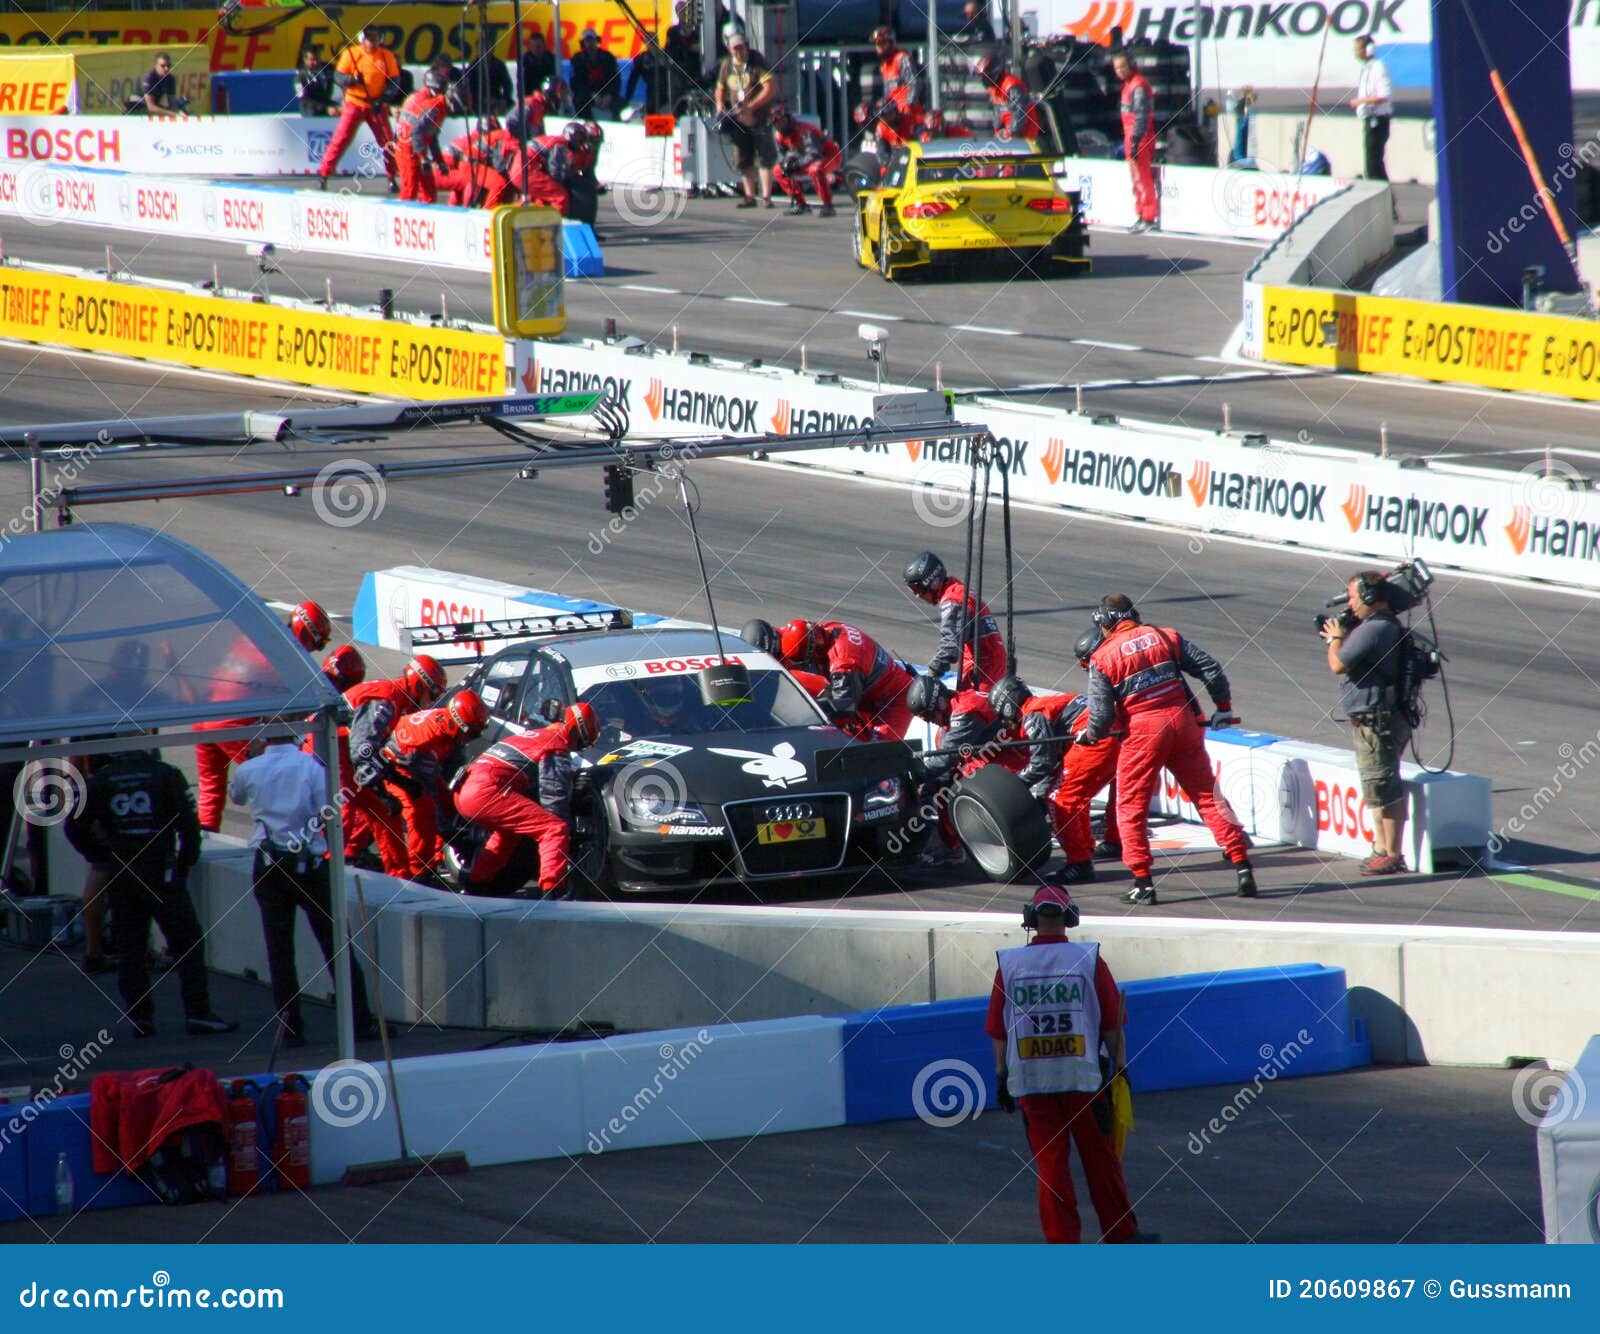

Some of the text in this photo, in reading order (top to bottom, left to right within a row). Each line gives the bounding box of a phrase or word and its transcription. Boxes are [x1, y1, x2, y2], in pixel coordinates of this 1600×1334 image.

[6, 128, 121, 163] BOSCH
[175, 144, 224, 156] SACHS
[55, 179, 97, 212] BOSCH
[136, 188, 179, 221] BOSCH
[223, 198, 265, 231] BOSCH
[306, 207, 349, 241] BOSCH
[393, 216, 436, 251] BOSCH
[502, 404, 536, 415] BRUNO
[644, 655, 746, 676] BOSCH
[110, 791, 152, 816] GQ
[1315, 779, 1375, 843] BOSC
[1013, 983, 1082, 1007] DEKRA
[1031, 1013, 1073, 1034] 125
[1030, 1036, 1078, 1058] ADAC
